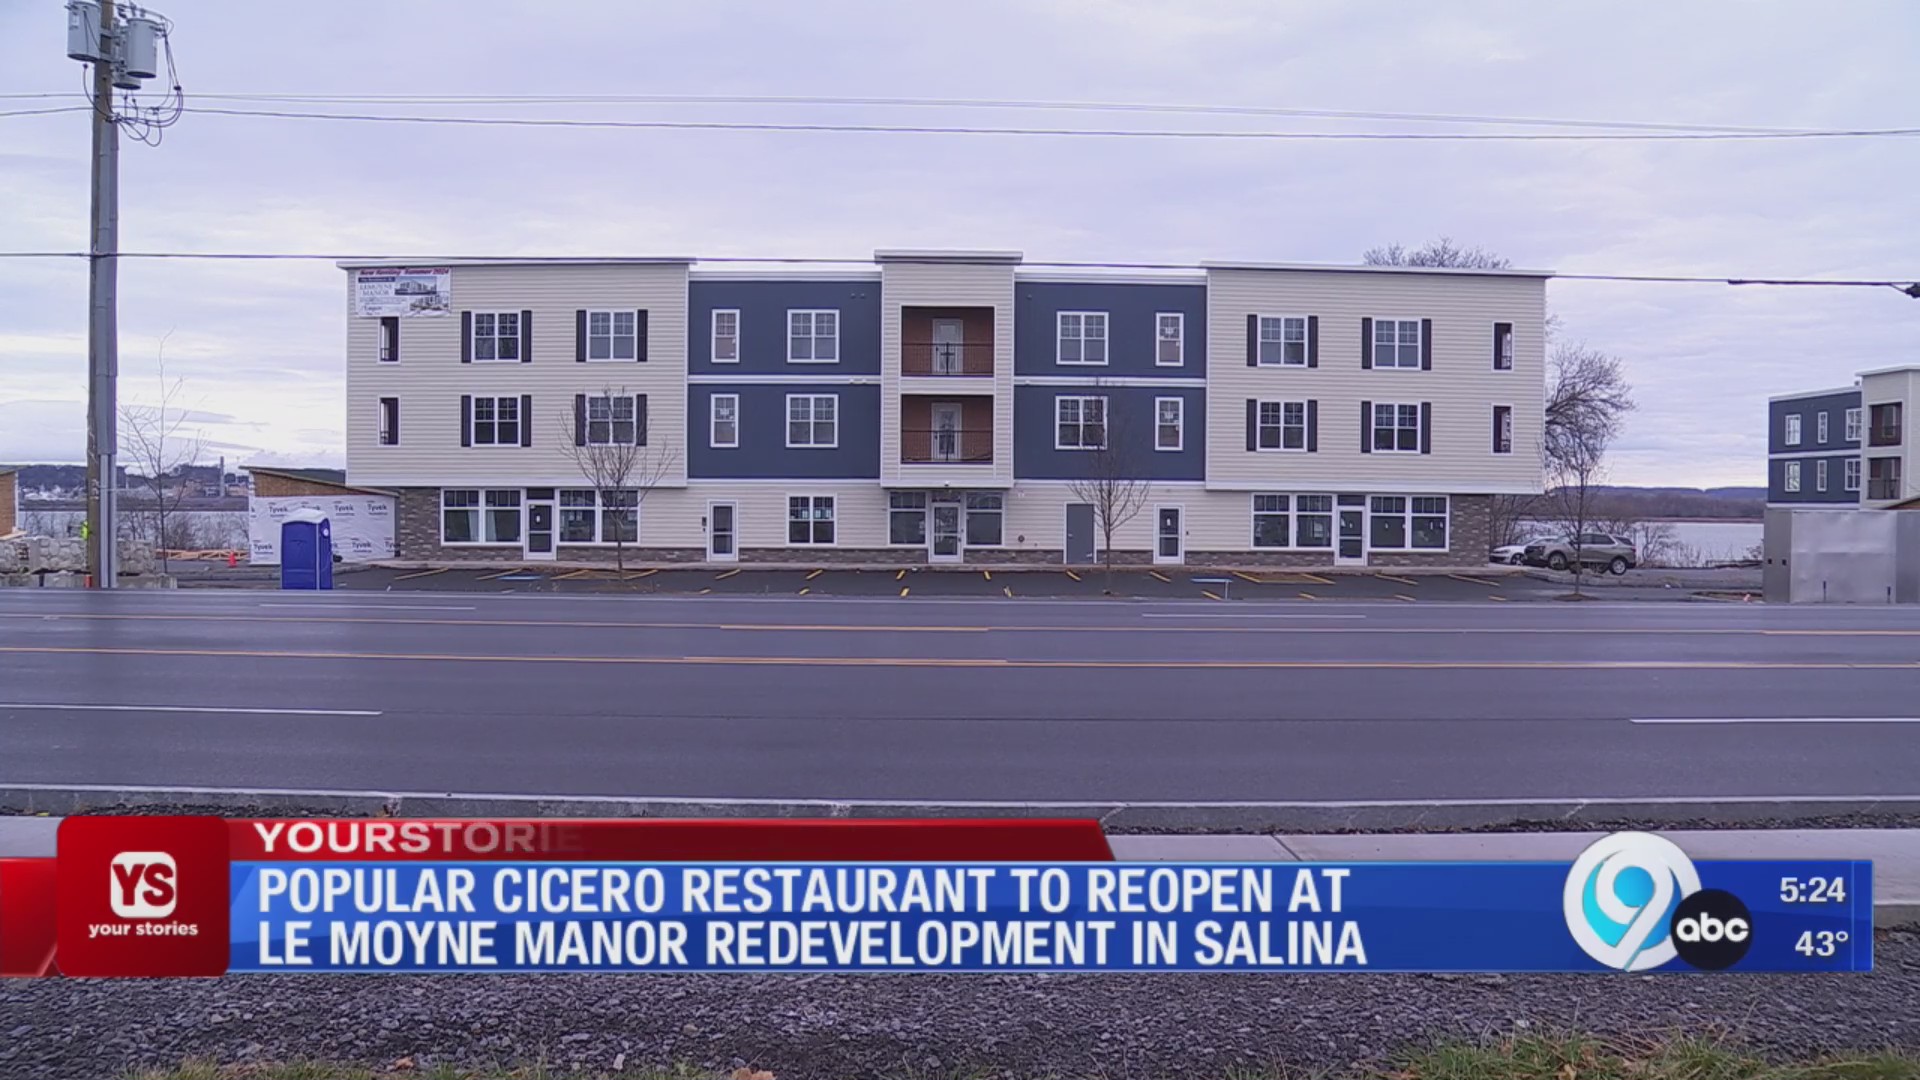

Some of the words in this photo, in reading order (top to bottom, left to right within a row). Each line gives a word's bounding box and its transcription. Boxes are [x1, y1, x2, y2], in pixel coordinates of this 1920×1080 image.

[269, 506, 288, 514] Tyvek
[334, 504, 354, 512] Tyvek
[367, 503, 388, 512] Tyvek
[253, 543, 273, 551] Tyvek
[352, 541, 372, 549] Tyvek
